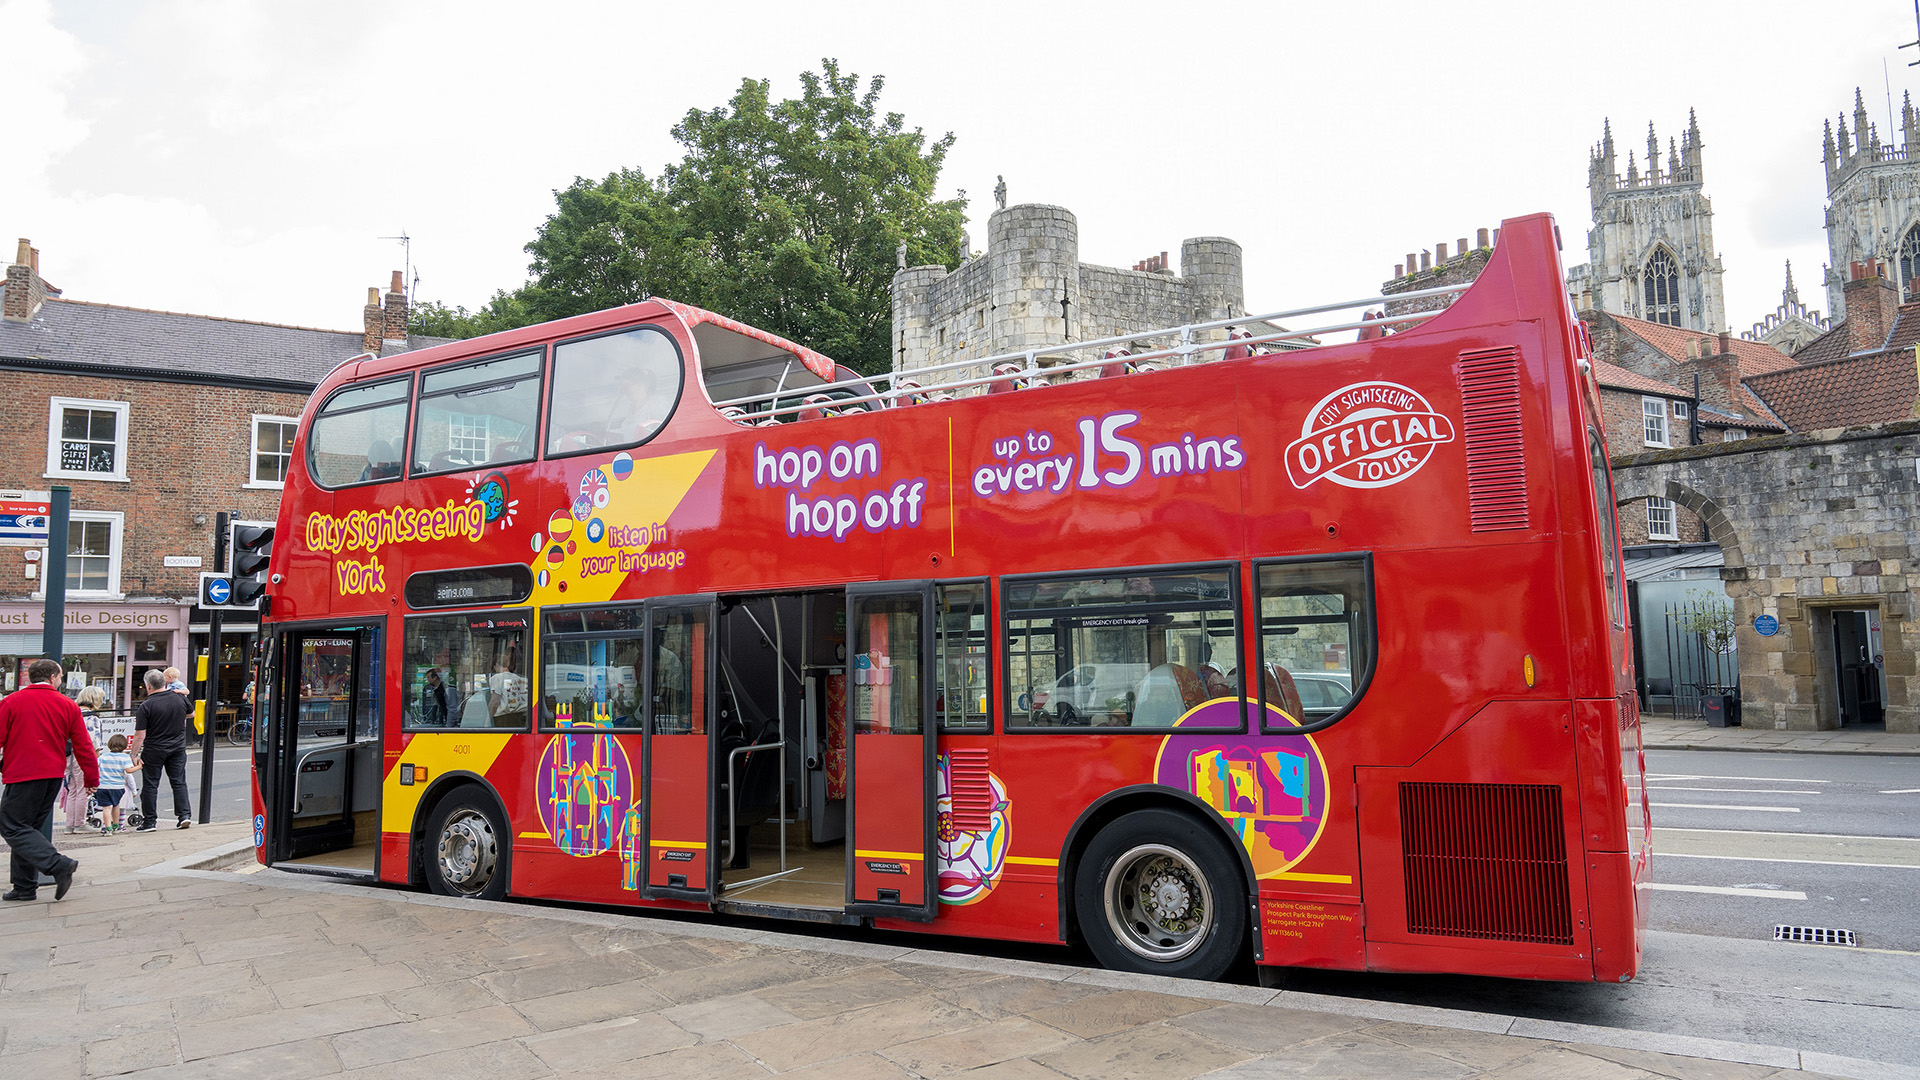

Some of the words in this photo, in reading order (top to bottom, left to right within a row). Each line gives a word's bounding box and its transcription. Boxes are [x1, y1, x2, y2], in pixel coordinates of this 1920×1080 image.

[1319, 402, 1342, 426] CITY
[1341, 388, 1416, 411] SIGHTSEEING
[62, 442, 88, 451] CARDS
[62, 451, 87, 459] GIFTS
[972, 455, 1074, 496] every
[1077, 412, 1143, 488] 15
[1150, 434, 1244, 476] mins
[994, 437, 1020, 459] up
[1026, 431, 1052, 452] to
[1298, 416, 1448, 475] OFFICIAL
[755, 443, 825, 490] hop
[828, 441, 878, 480] on
[1356, 450, 1418, 480] TOUR
[787, 491, 858, 540] hop
[863, 480, 925, 530] off
[609, 525, 648, 548] listen
[652, 522, 668, 544] in
[581, 556, 616, 578] your
[618, 550, 686, 574] language
[98, 611, 168, 628] Designs
[147, 641, 156, 652] 5
[453, 744, 471, 754] 4001
[1267, 910, 1292, 918] Prospect
[1307, 912, 1338, 921] Broughton
[1339, 914, 1352, 922] Way
[1268, 918, 1297, 926] Harrogate
[1295, 930, 1303, 938] kg
